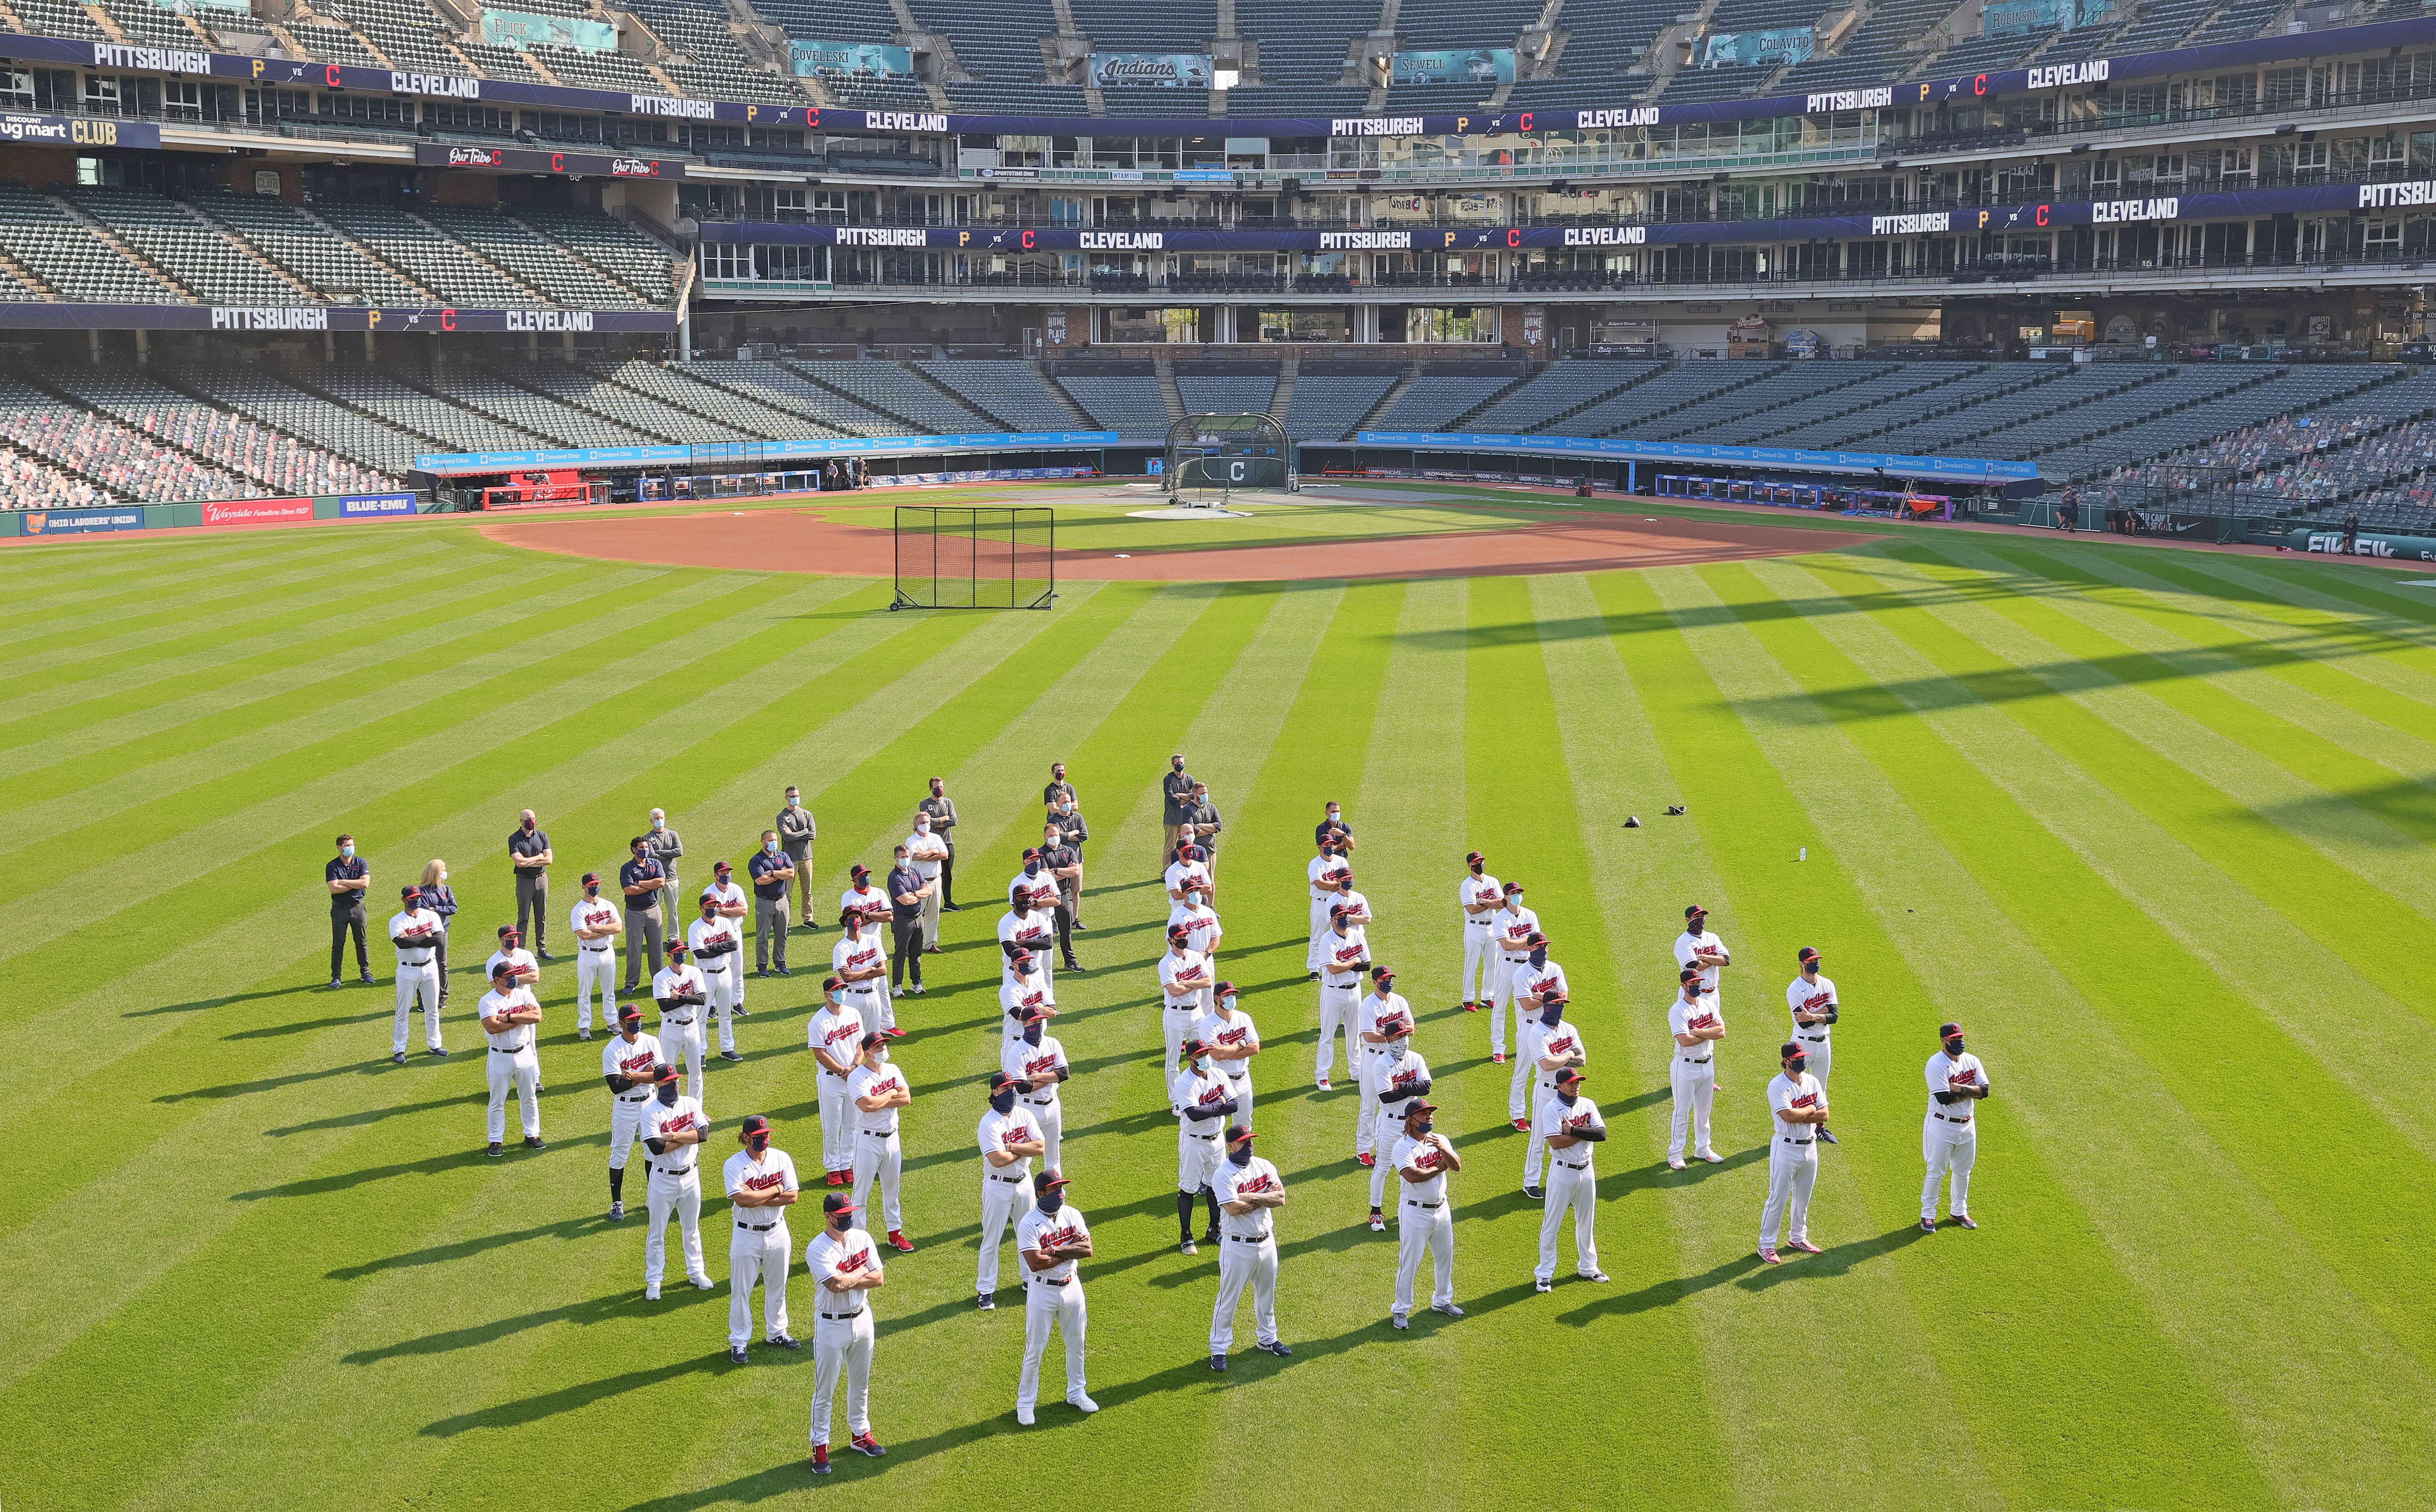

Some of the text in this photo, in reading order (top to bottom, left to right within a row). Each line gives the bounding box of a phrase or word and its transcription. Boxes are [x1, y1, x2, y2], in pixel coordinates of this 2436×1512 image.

[494, 19, 527, 36] FLICK
[1992, 9, 2039, 28] ROBINSON
[1759, 36, 1809, 52] COLAVITO
[792, 47, 849, 63] COVELESKI
[94, 43, 480, 99] PITTSBURGH P VS C CLEVELAND
[1096, 59, 1178, 84] Indians
[1402, 59, 1445, 71] SEWELL
[1807, 87, 1892, 113] PITTSBURGH
[1919, 83, 1930, 101] P
[1974, 74, 1987, 95] C
[2028, 60, 2109, 89] CLEVELAND
[5, 116, 41, 124] DISCOUNT
[631, 94, 715, 119] PITTSBURGH
[747, 105, 758, 121] P
[807, 109, 819, 126] C
[866, 111, 948, 131] CLEVELAND
[1332, 118, 1423, 135] PITTSBURGH
[1457, 117, 1469, 132] P
[1520, 114, 1533, 131] C
[1578, 107, 1659, 128] CLEVELAND
[0, 120, 117, 145] ug mart CLUB
[449, 148, 502, 165] Our Tribe C
[552, 154, 563, 172] C
[612, 159, 659, 175] Our Tribe C
[2359, 180, 2436, 208] PITTSBU
[1872, 197, 2179, 235] PITTSBURGH P VS C CLEVELAND
[836, 228, 926, 247] PITTSBURGH
[958, 231, 970, 247] P
[1022, 231, 1034, 248] C
[1079, 232, 1163, 249] CLEVELAND
[1320, 232, 1411, 249] PITTSBURGH
[1444, 232, 1456, 248] P
[1507, 229, 1520, 247] C
[1564, 227, 1646, 246] CLEVELAND
[212, 307, 328, 330] PITTSBURGH
[368, 310, 382, 330] P
[442, 310, 456, 331] C
[507, 311, 593, 331] CLEVELAND
[1048, 317, 1066, 327] HOME
[1524, 317, 1542, 328] HOME
[1048, 329, 1066, 339] PLATE
[1524, 329, 1542, 340] PLATE
[1230, 461, 1245, 481] C
[207, 503, 252, 521] Wayside
[347, 500, 408, 511] BLUE-EMU
[49, 519, 69, 528] OHIO
[70, 517, 110, 527] LABORERS'
[111, 515, 136, 524] UNION
[2355, 539, 2395, 558] Elk
[586, 910, 611, 924] Indian
[1016, 926, 1040, 939] Indian
[1509, 923, 1531, 937] Indian
[1376, 1011, 1404, 1027] Indian
[1026, 1054, 1056, 1074] Indian
[1949, 1069, 1976, 1084] Indian
[661, 1111, 694, 1132] Indian
[1001, 1125, 1027, 1143] Indian
[745, 1170, 783, 1190] Indian
[842, 1195, 850, 1204] C
[1039, 1225, 1076, 1247] Indian
[836, 1247, 869, 1272] Indian
